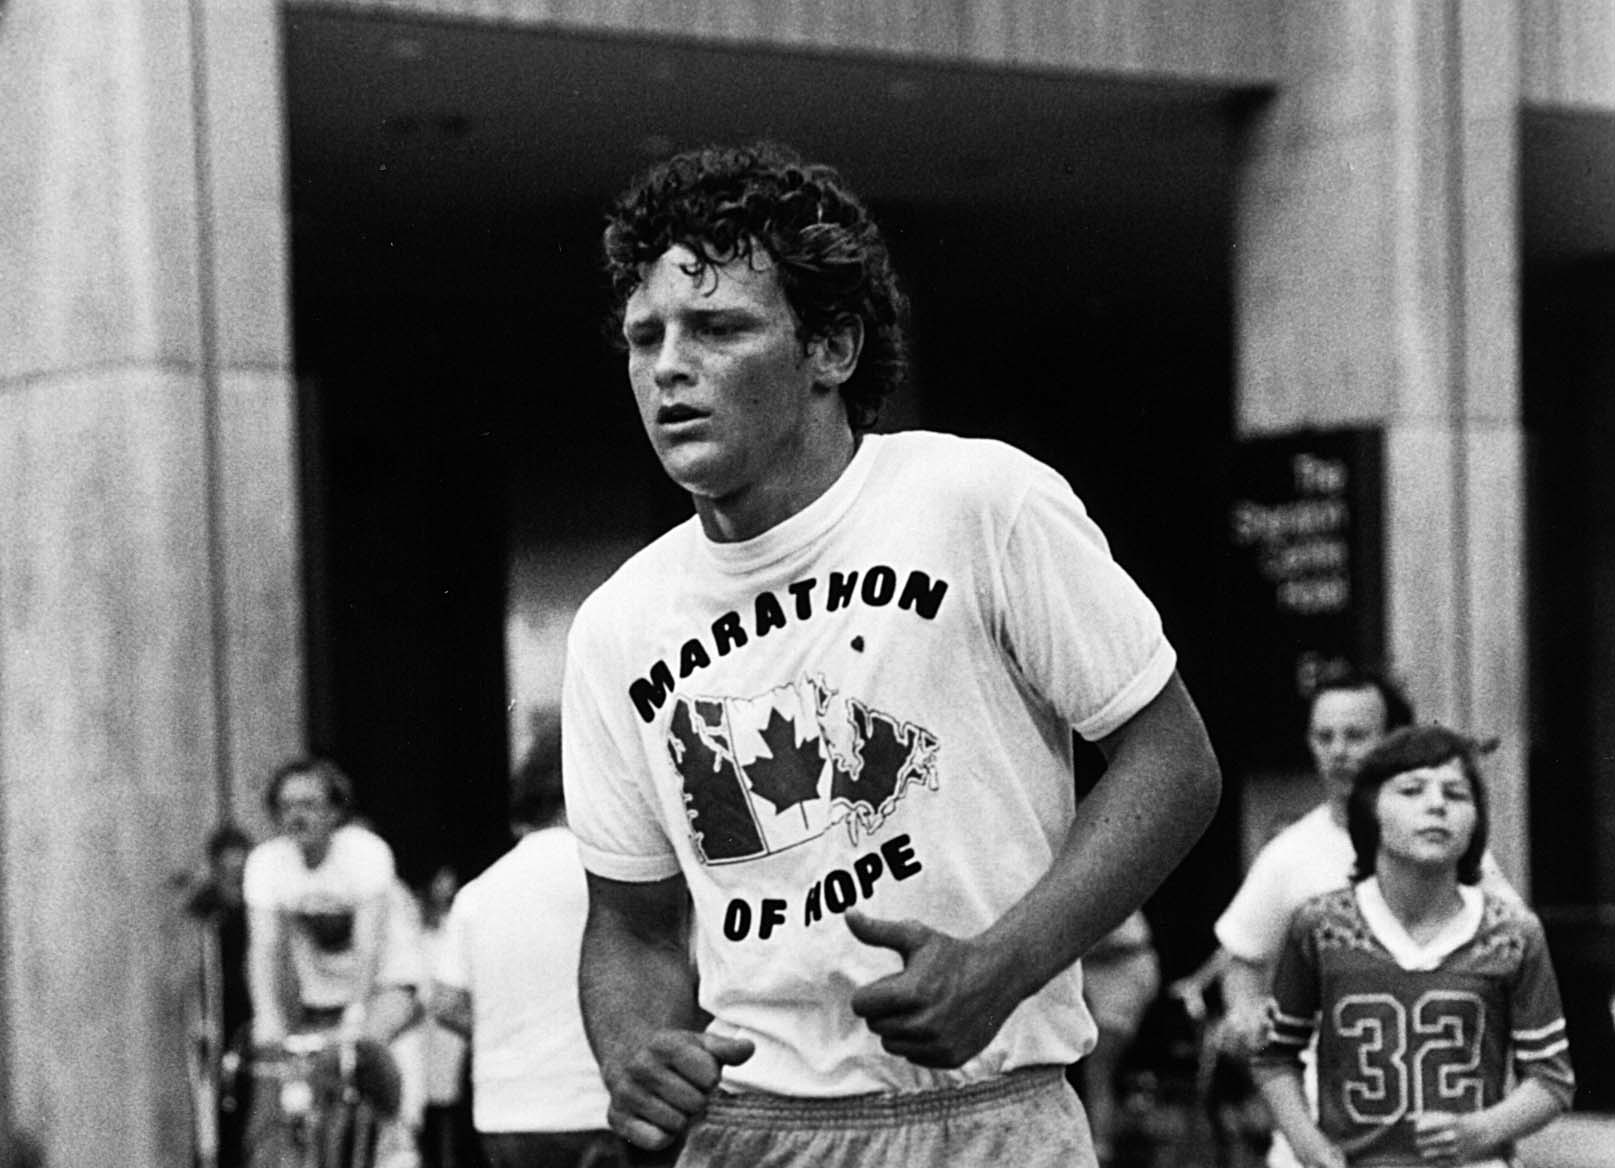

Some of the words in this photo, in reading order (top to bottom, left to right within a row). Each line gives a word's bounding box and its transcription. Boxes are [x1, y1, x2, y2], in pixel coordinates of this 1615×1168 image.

[628, 565, 948, 723] MARATHON
[723, 898, 787, 941] OF
[804, 833, 922, 927] HOPE
[1333, 990, 1486, 1125] 32
